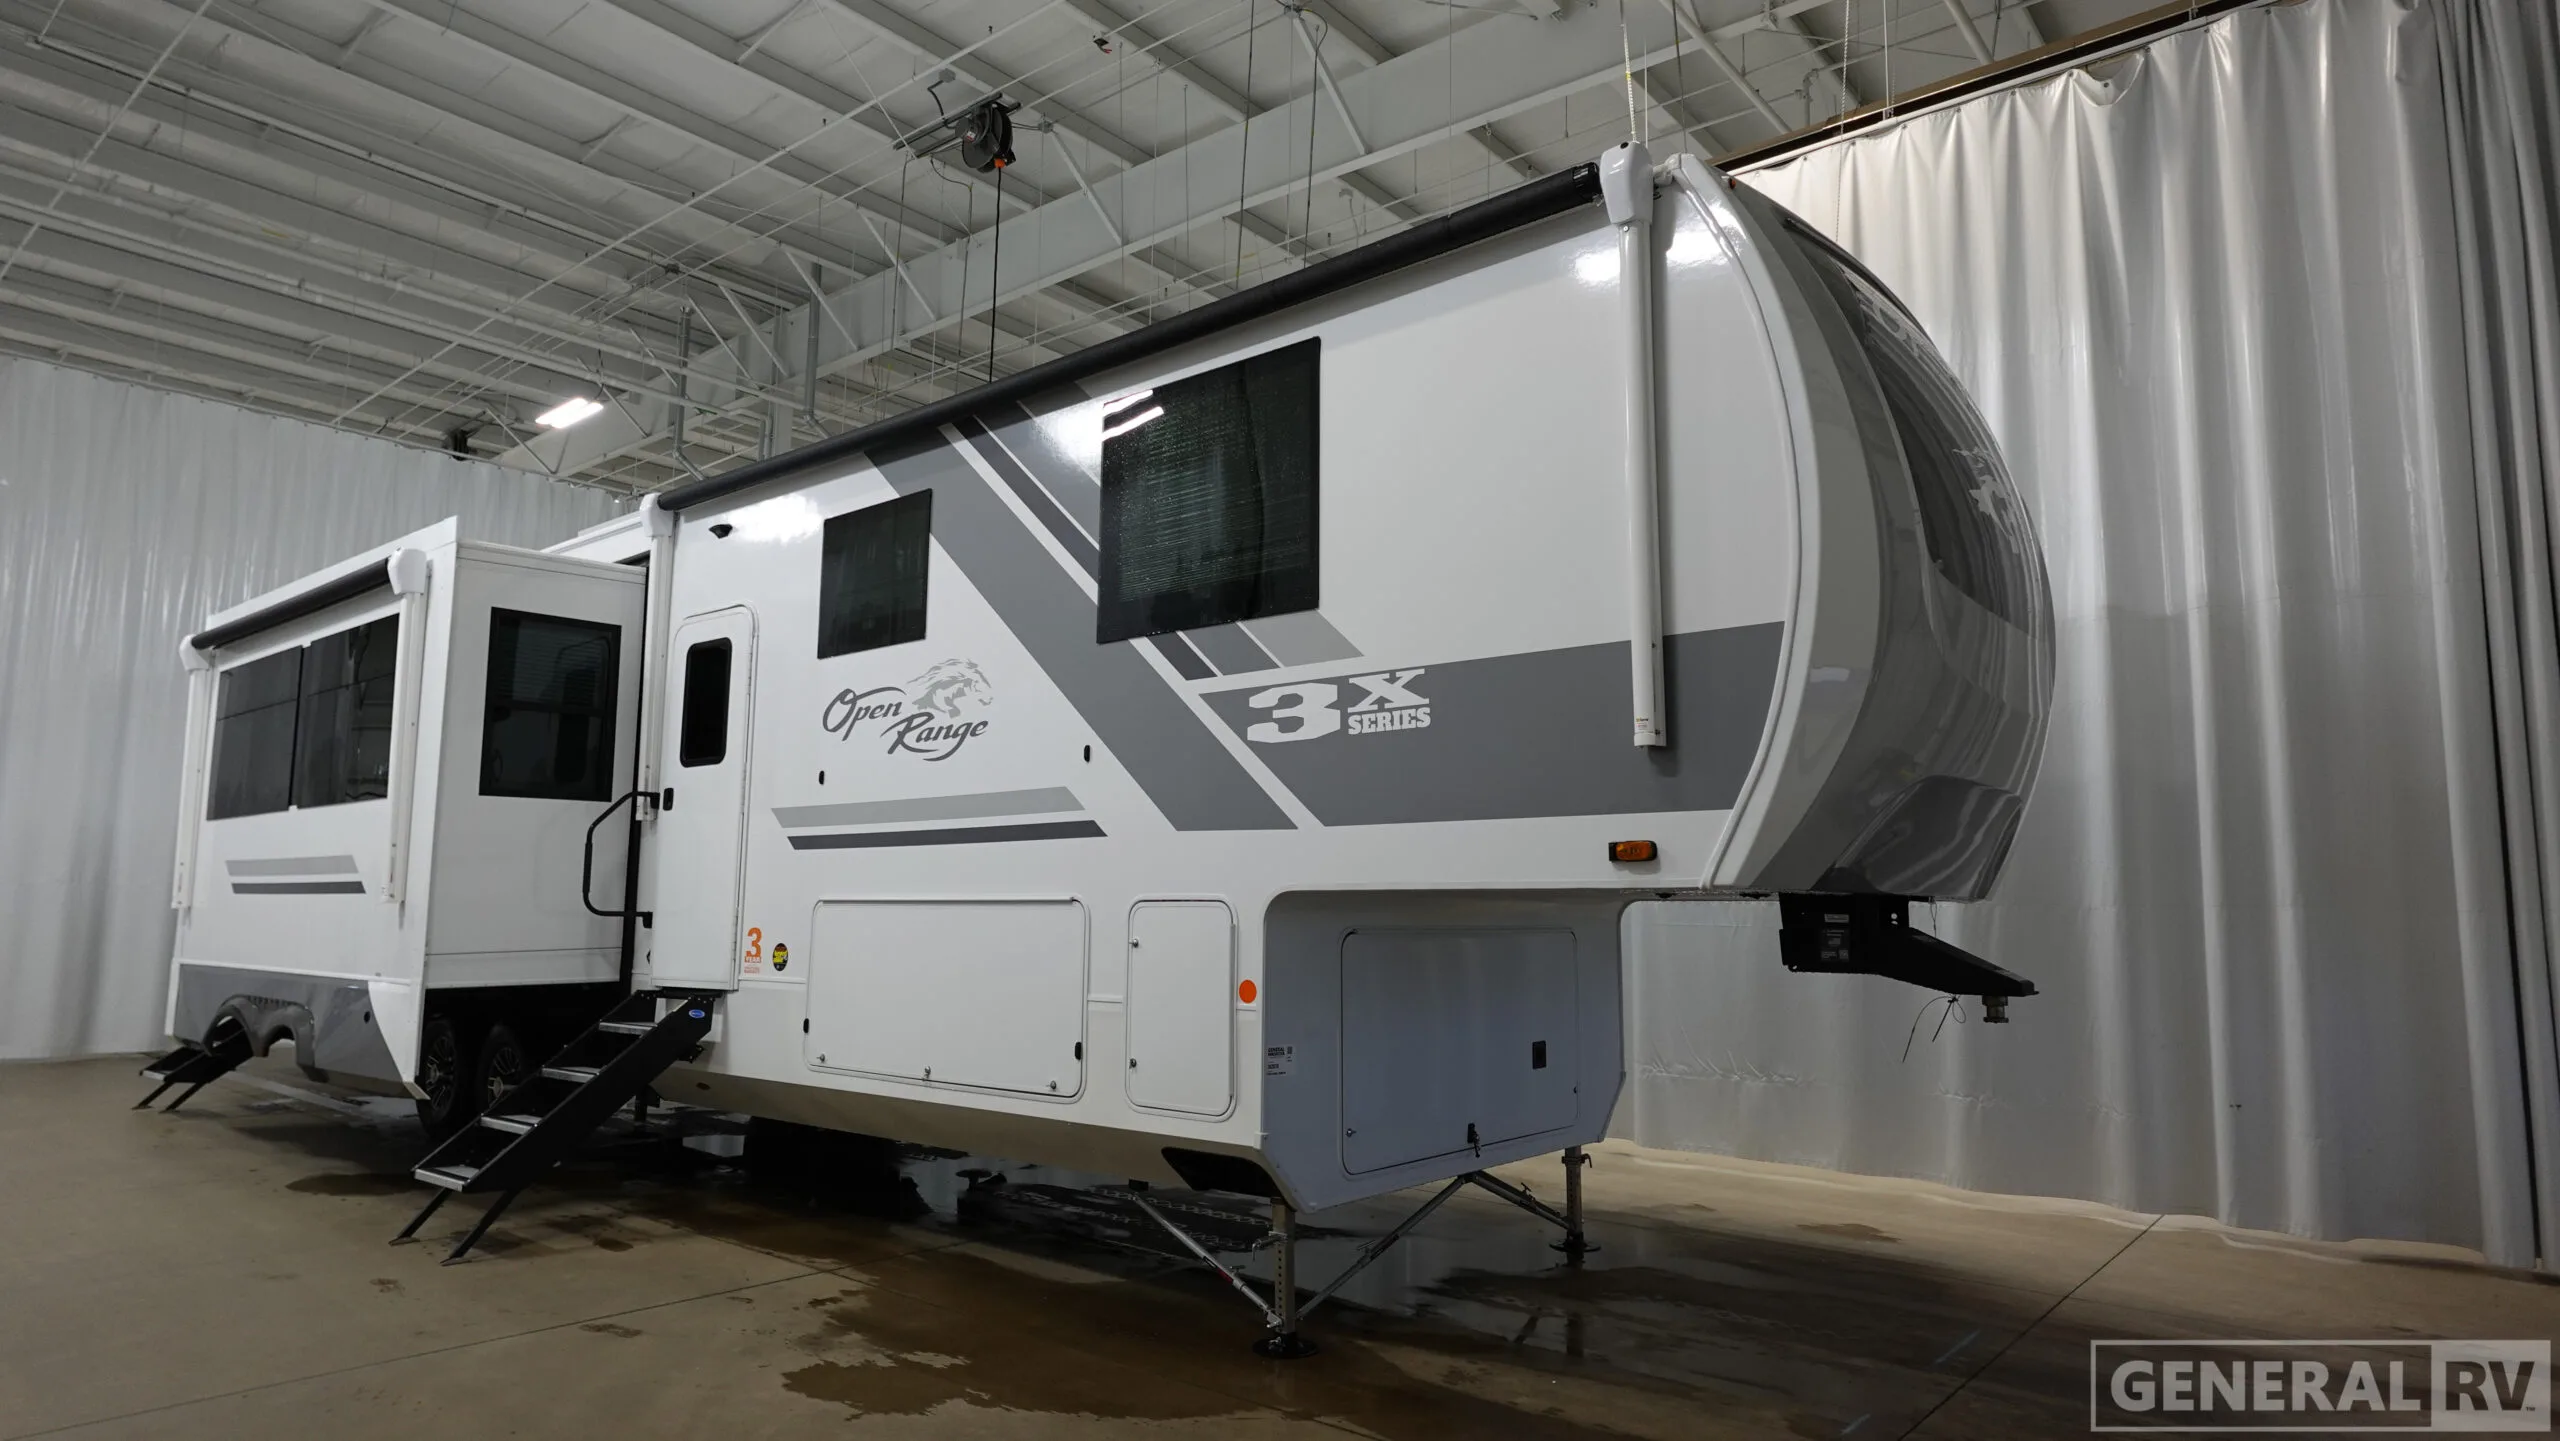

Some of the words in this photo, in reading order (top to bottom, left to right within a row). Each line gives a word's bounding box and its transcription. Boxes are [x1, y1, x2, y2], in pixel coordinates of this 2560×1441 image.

[823, 686, 907, 741] Open
[1348, 707, 1431, 735] SERIES
[880, 712, 988, 761] Range
[746, 927, 762, 957] 3
